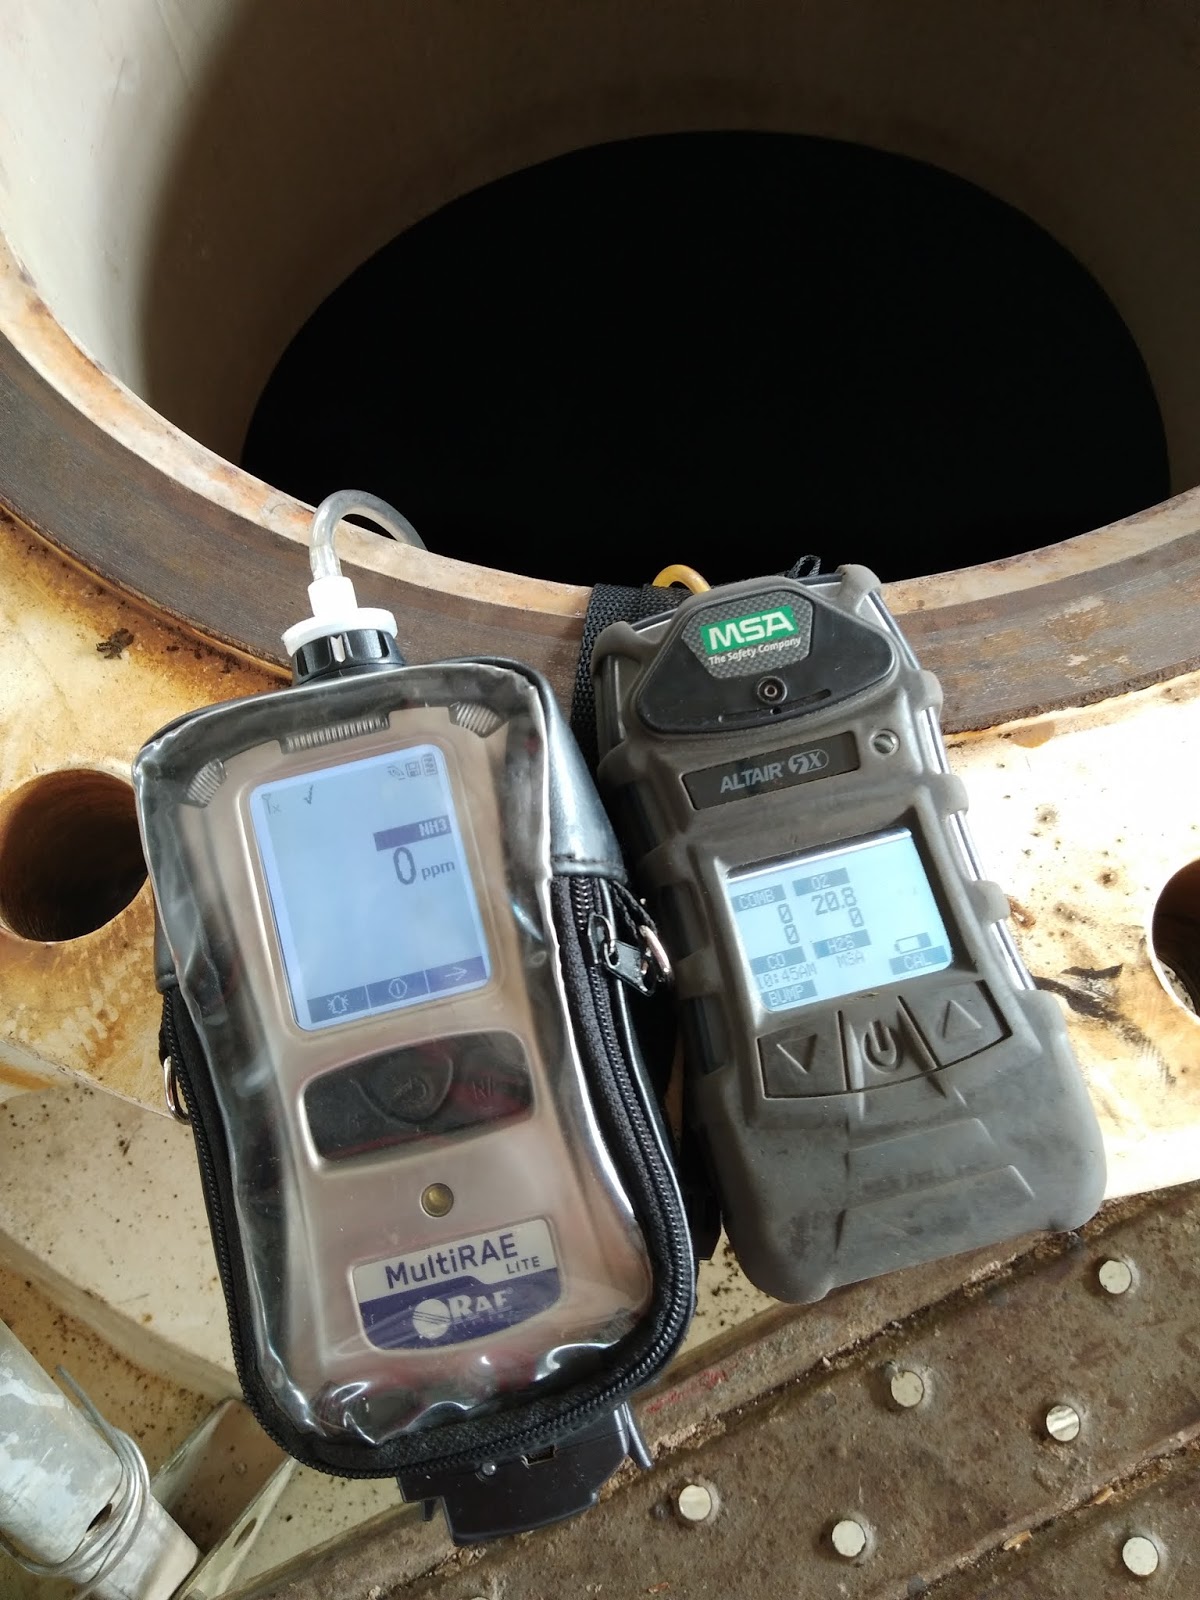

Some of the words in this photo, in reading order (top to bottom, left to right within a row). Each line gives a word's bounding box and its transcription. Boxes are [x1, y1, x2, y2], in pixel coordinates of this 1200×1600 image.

[708, 611, 794, 650] MSA
[708, 655, 726, 666] The
[727, 646, 757, 662] Safety
[758, 637, 802, 654] Company
[720, 763, 784, 793] ALTAIR
[418, 818, 449, 837] NH3
[393, 846, 417, 885] 0
[421, 860, 456, 880] ppm
[739, 890, 775, 910] COMB
[811, 886, 857, 916] 20.8
[903, 953, 932, 970] CAL
[769, 986, 804, 1006] BUMP
[384, 1233, 519, 1289] MultiRAE
[505, 1255, 541, 1275] LITE
